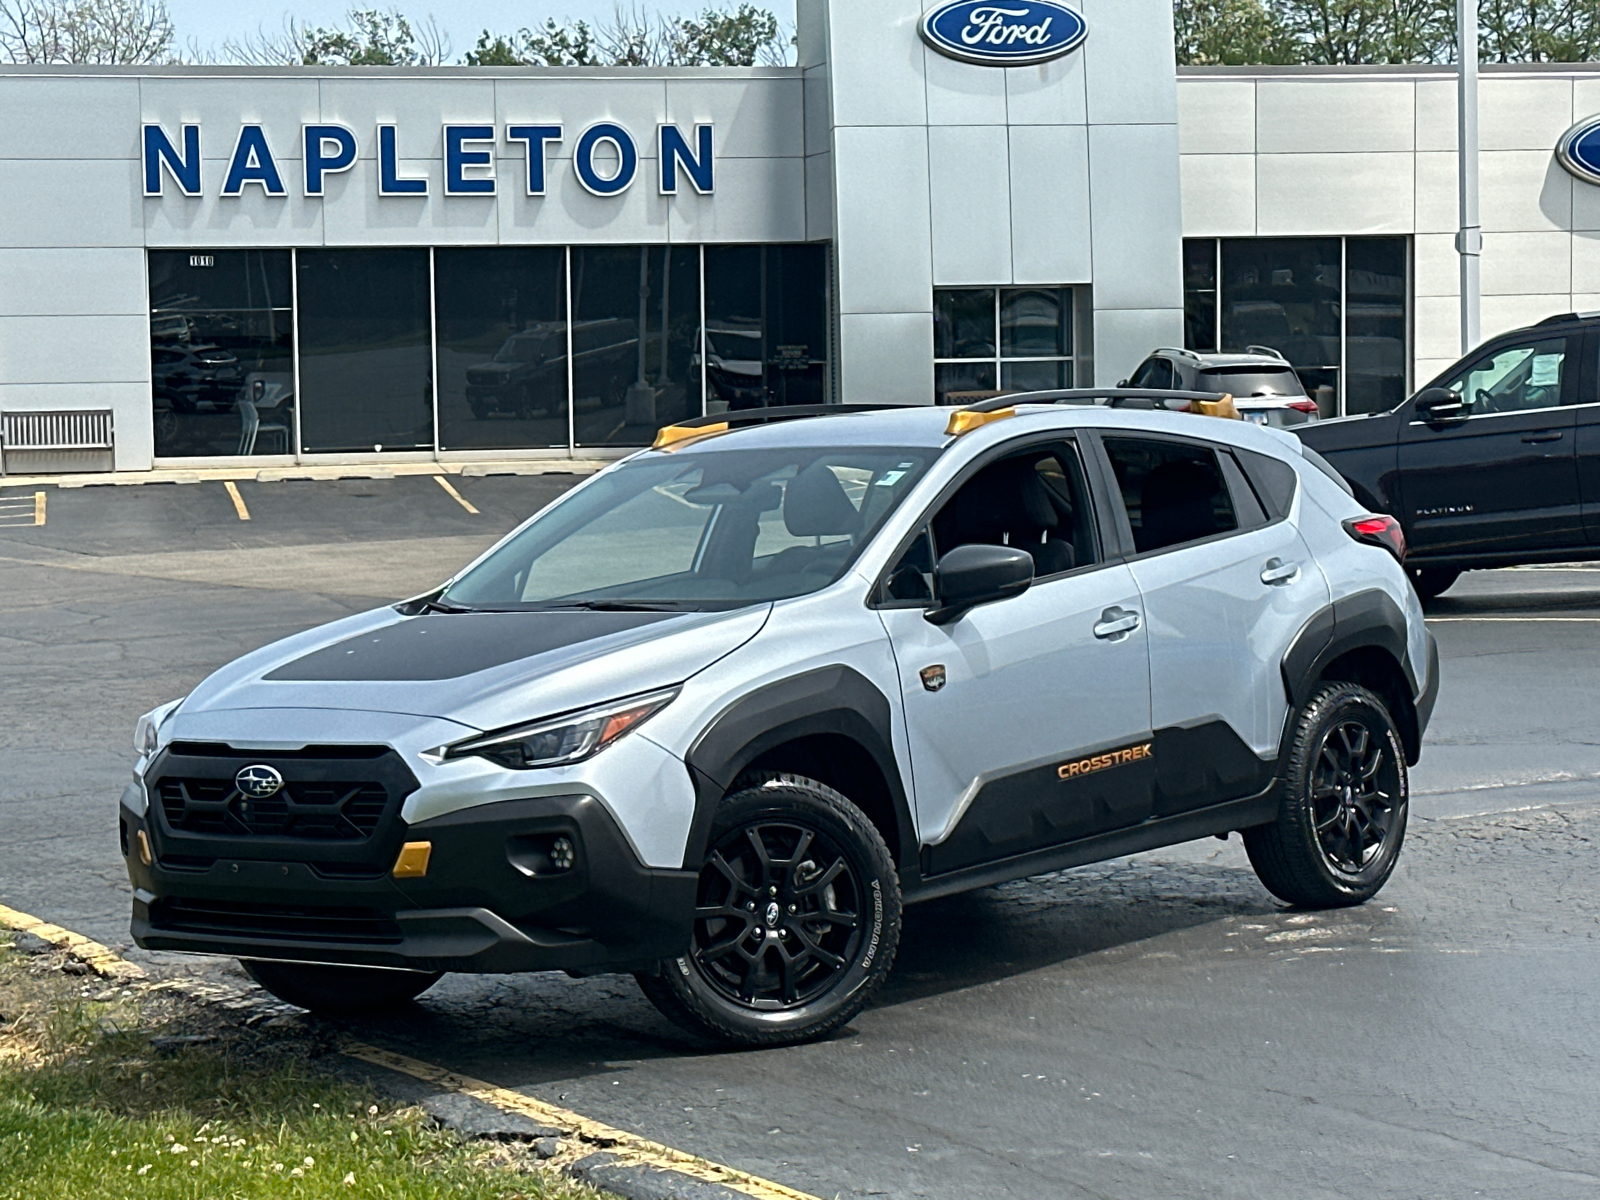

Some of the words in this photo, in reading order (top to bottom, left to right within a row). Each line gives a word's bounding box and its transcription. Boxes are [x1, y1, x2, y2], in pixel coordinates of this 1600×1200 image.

[961, 7, 1053, 45] Ford
[142, 121, 716, 198] NAPLETON
[190, 255, 214, 267] 1010
[1416, 505, 1474, 516] PLATINUM
[1057, 743, 1153, 779] CROSSTREK
[861, 879, 883, 968] YOKOHAMA
